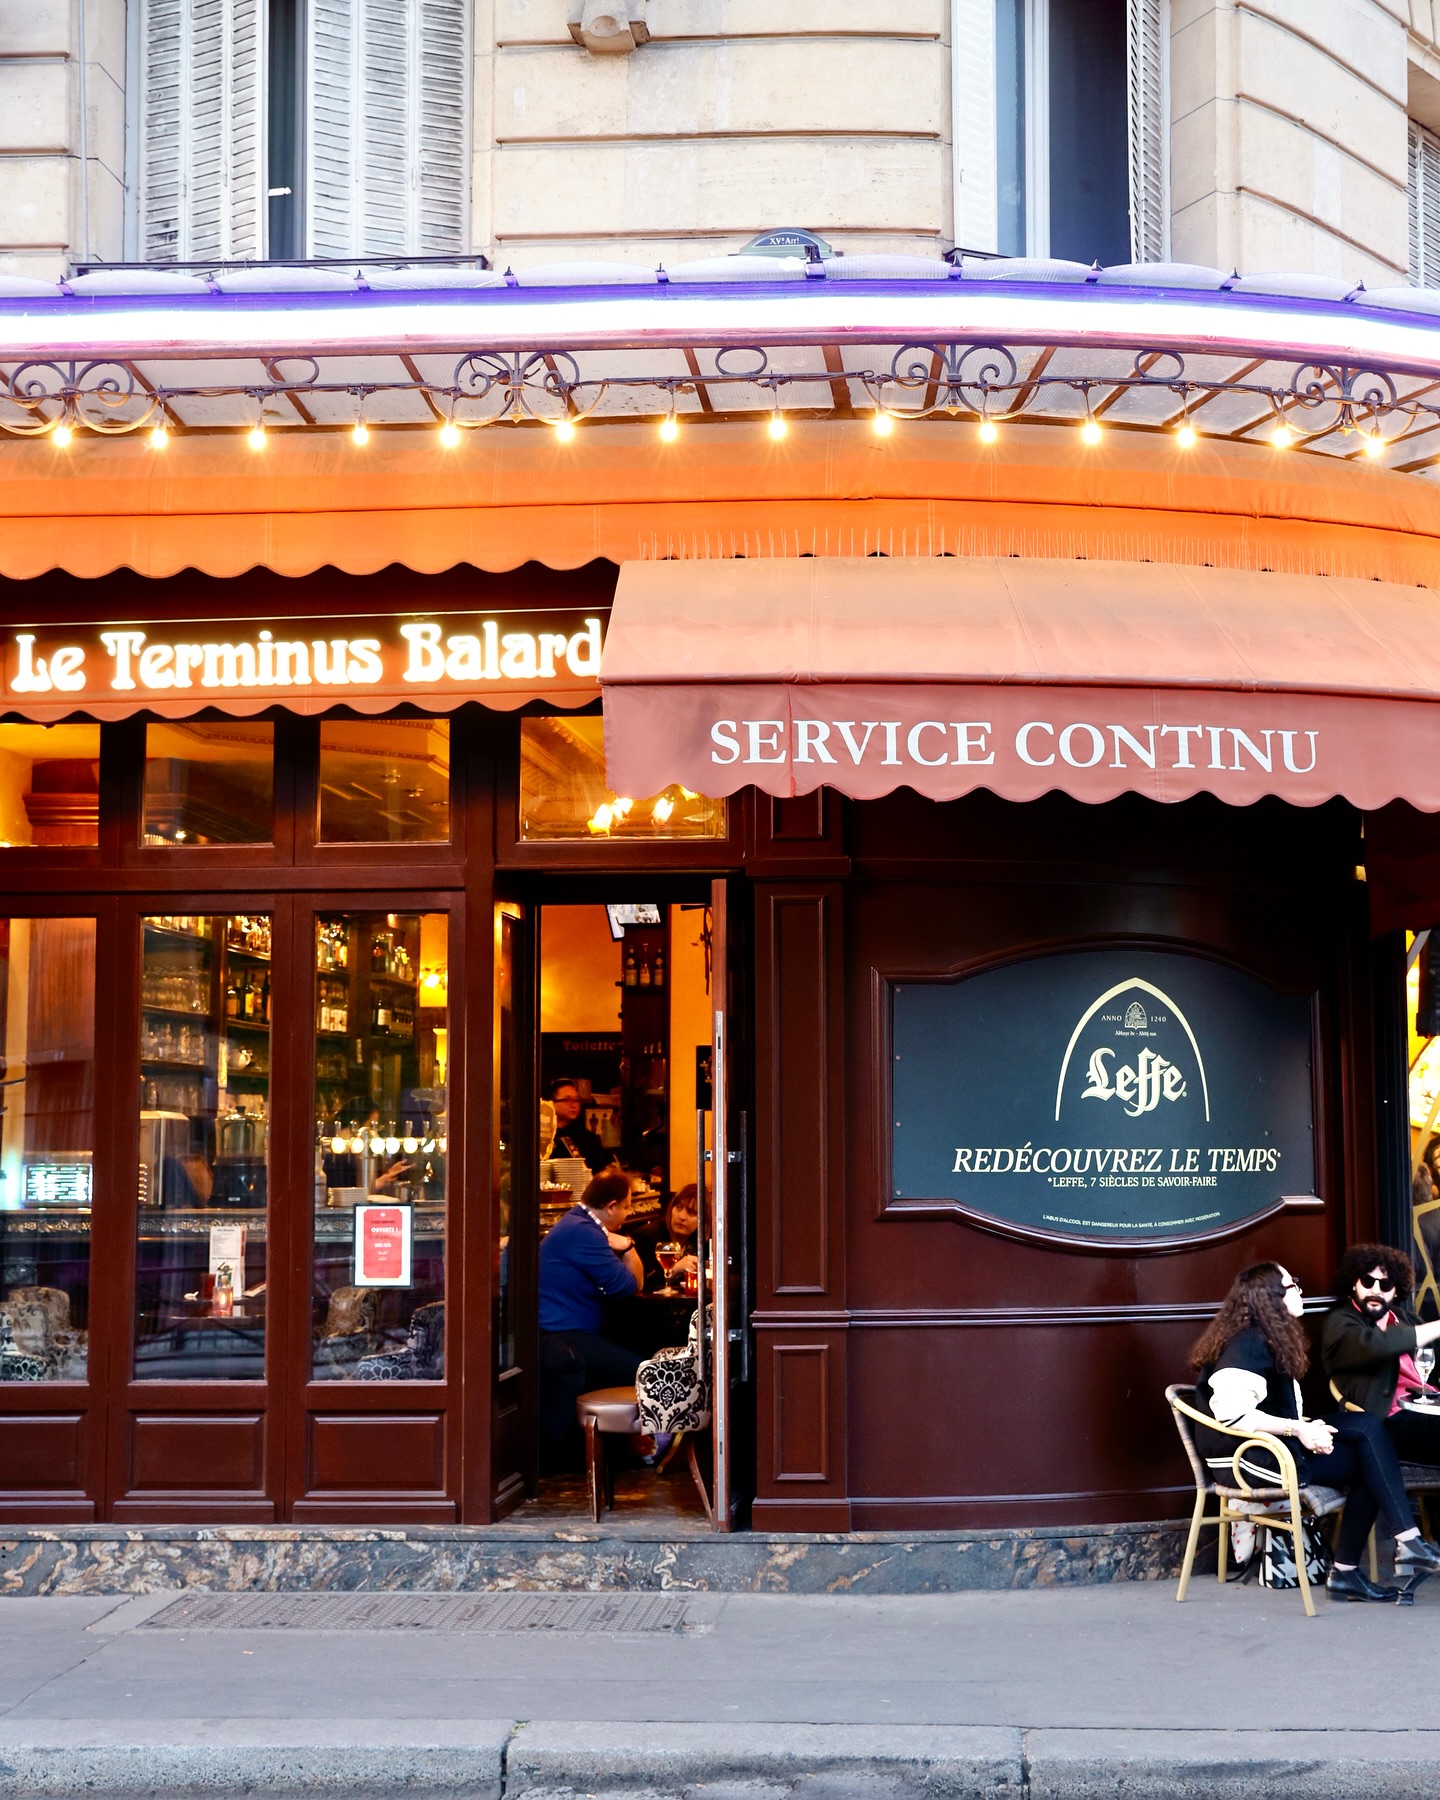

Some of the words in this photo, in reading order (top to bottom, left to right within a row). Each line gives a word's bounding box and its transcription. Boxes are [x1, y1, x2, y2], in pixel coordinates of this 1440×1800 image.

[10, 634, 87, 692] Le
[100, 630, 384, 691] Terminus
[400, 618, 603, 683] Balard
[709, 719, 996, 767] SERVICE
[1014, 721, 1320, 774] CONTINU
[1080, 1046, 1187, 1117] Leffe
[952, 1142, 1163, 1173] REDÉCOUVREZ
[1169, 1149, 1200, 1173] LE
[1090, 1178, 1097, 1187] 7
[1099, 1175, 1139, 1187] SIÈCLES
[1141, 1176, 1155, 1187] DE
[1157, 1176, 1218, 1187] SAVOIR-FAIRE
